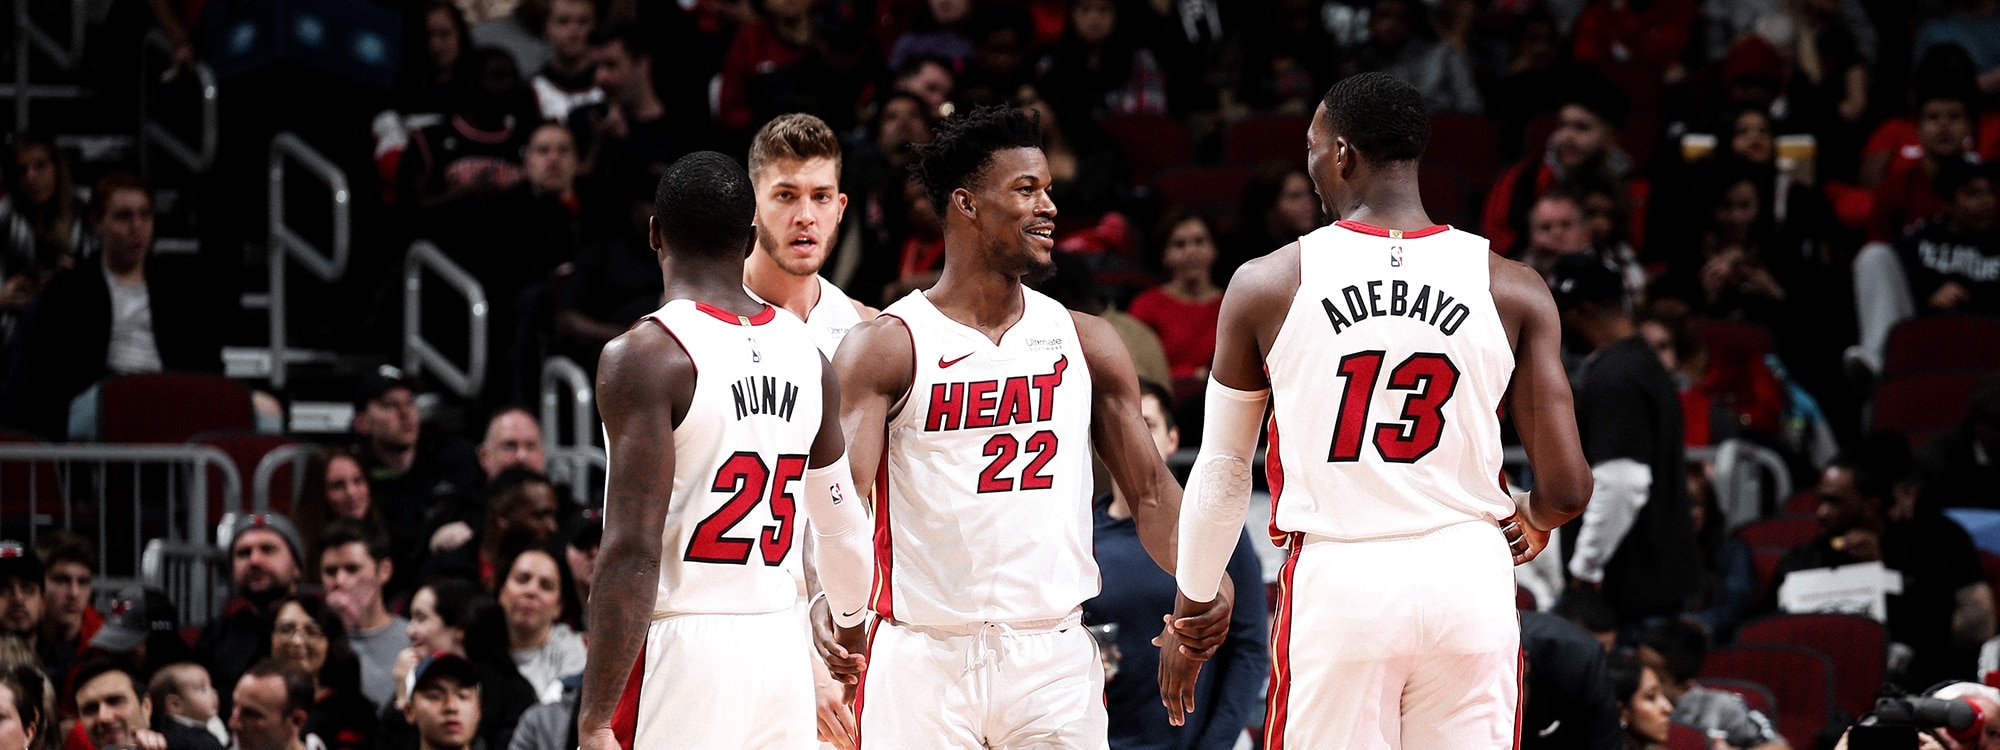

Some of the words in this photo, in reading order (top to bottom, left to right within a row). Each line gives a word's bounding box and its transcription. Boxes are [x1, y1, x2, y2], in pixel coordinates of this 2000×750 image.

[1321, 280, 1470, 336] ADEBAYO
[731, 375, 799, 423] NUNN
[924, 353, 1069, 432] HEAT
[1327, 350, 1461, 464] 13
[977, 430, 1059, 494] 22
[683, 451, 810, 567] 25
